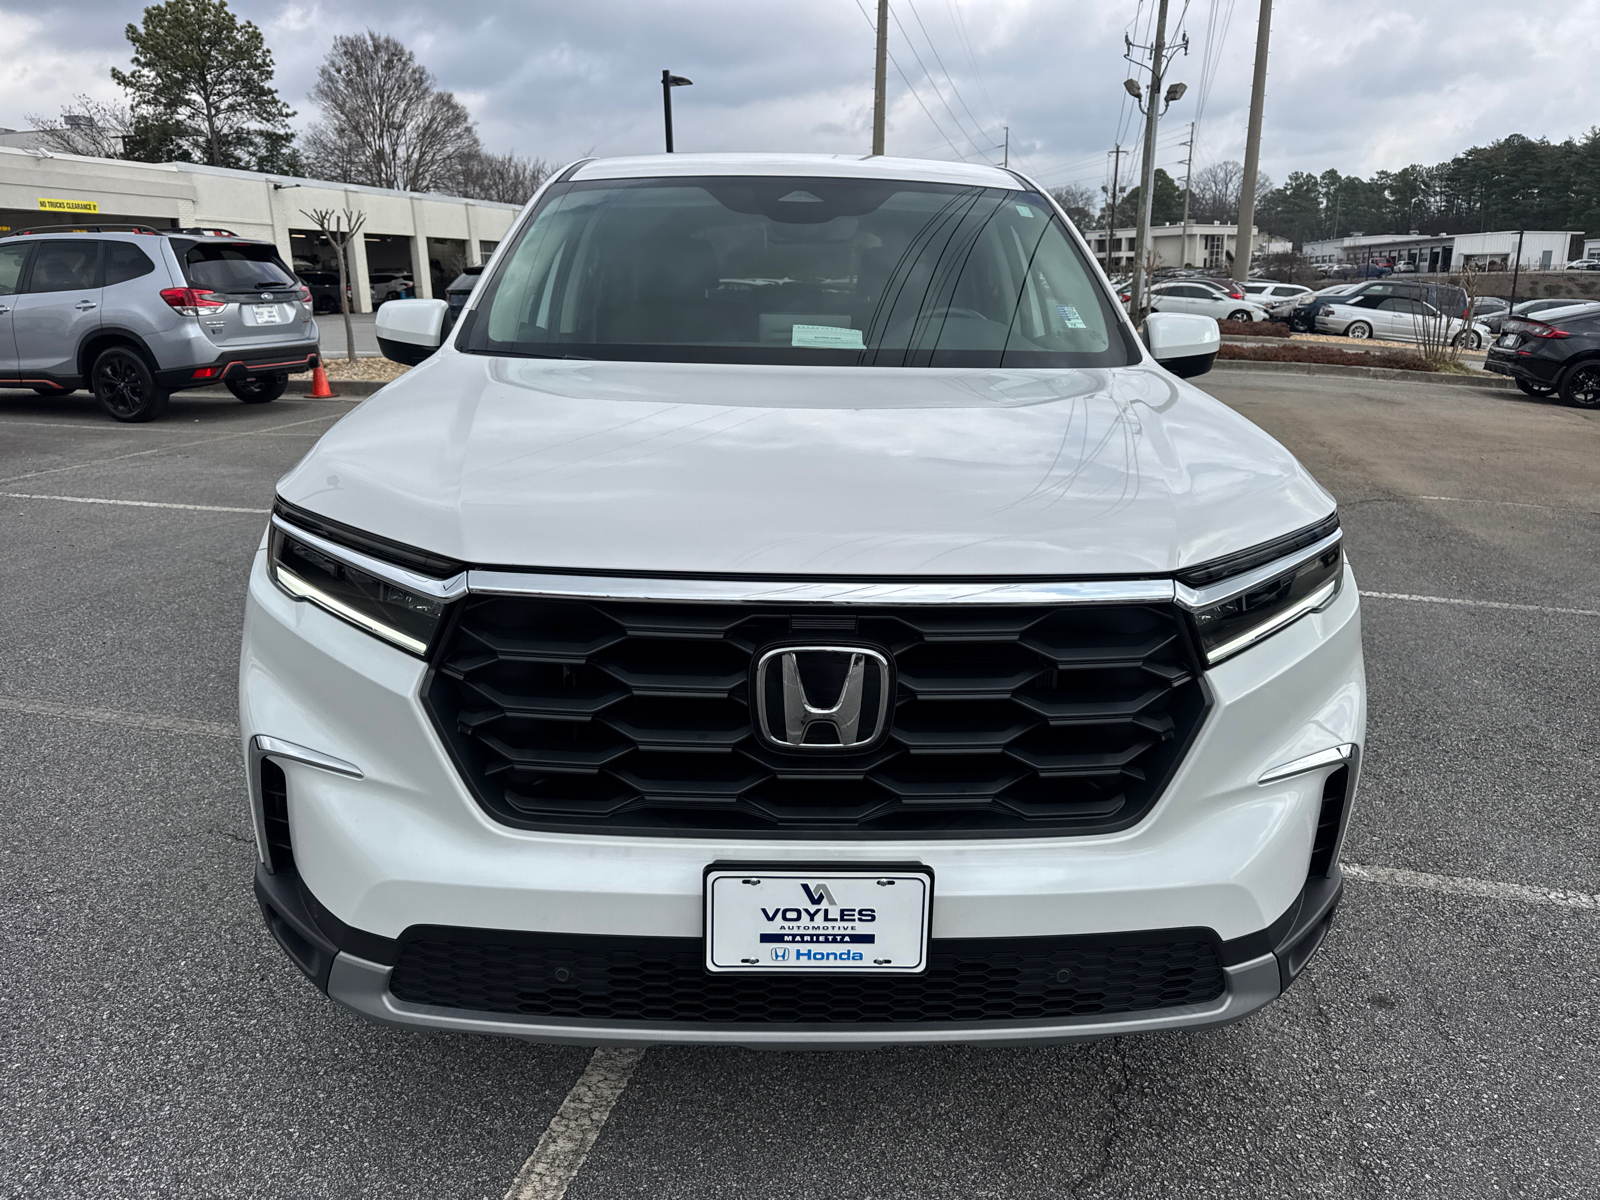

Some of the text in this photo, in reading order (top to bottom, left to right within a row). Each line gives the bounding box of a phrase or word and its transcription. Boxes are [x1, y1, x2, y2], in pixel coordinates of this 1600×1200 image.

[39, 200, 47, 208] NO
[47, 201, 66, 209] TRUCKS
[66, 202, 92, 211] CLEARANCE
[760, 907, 876, 922] VOYLES
[795, 949, 864, 961] Honda
